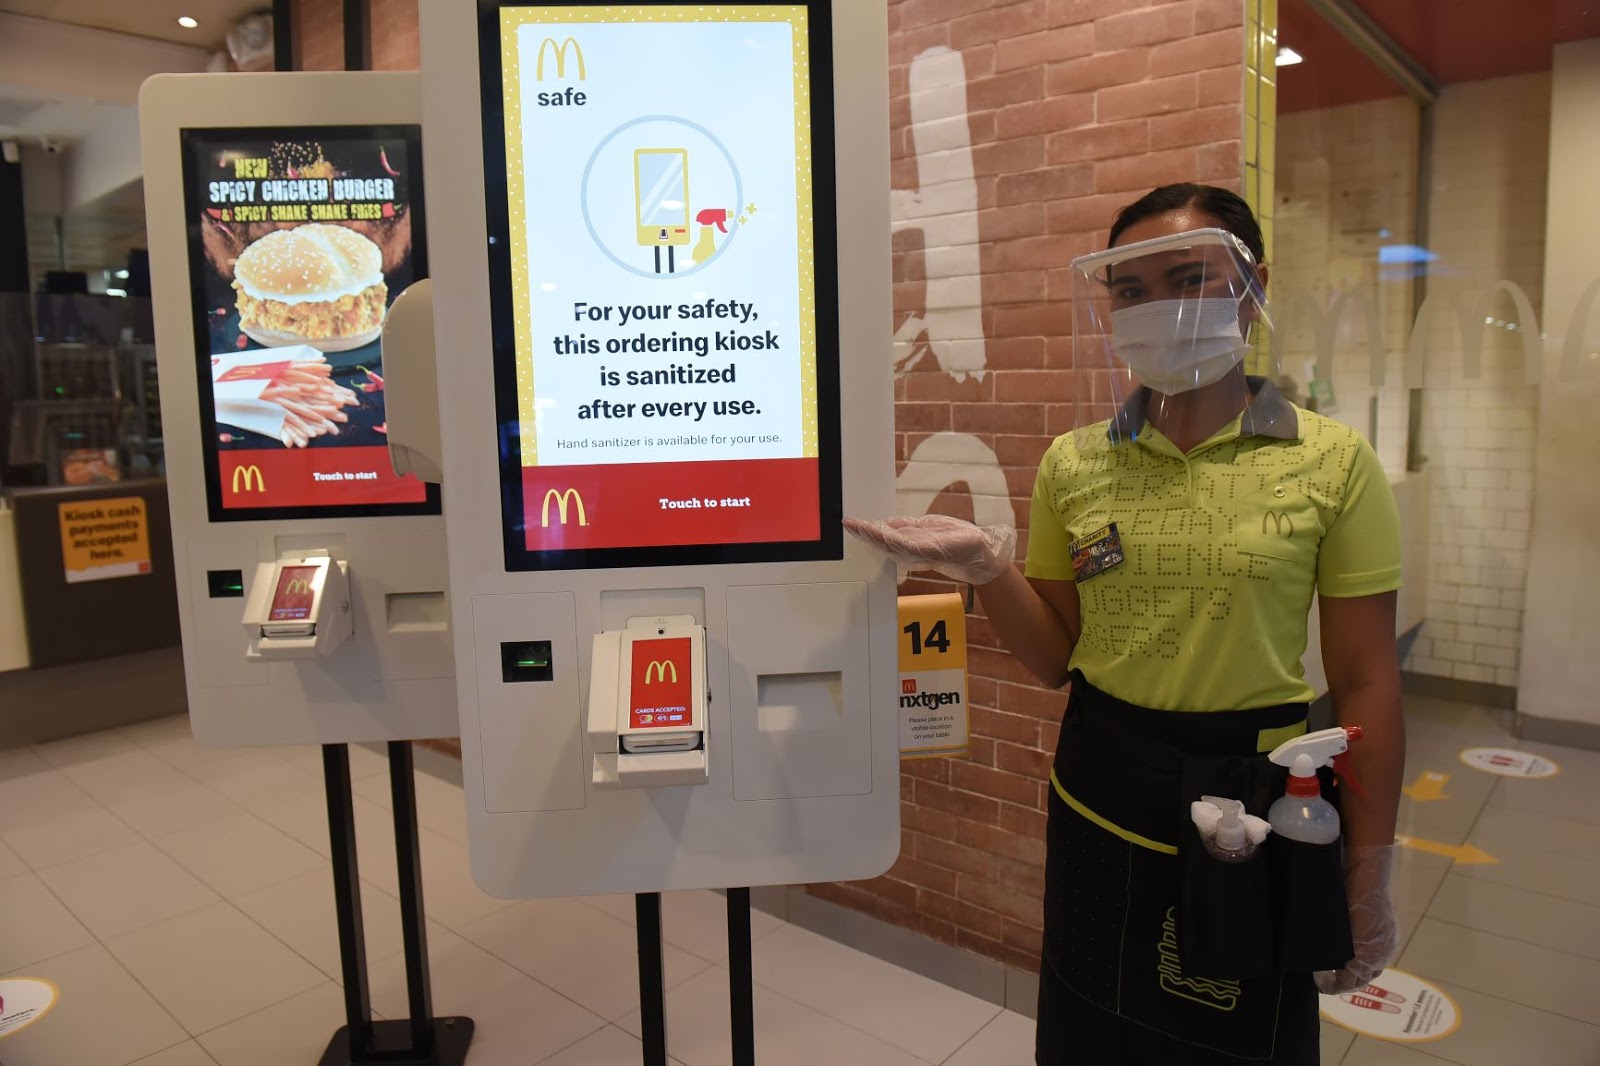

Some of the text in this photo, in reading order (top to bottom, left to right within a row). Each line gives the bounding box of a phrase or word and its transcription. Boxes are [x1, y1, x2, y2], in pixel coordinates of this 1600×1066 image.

[537, 87, 587, 107] safe
[234, 157, 269, 179] NEW
[333, 177, 395, 200] BURGER
[271, 203, 308, 221] SHAKE
[311, 203, 348, 220] SHAKE
[573, 298, 759, 326] For your safety,
[553, 330, 780, 357] this ordering kiosk
[600, 363, 737, 387] is sanitized
[577, 398, 761, 422] after every use.
[557, 433, 783, 449] Hand sanitizer is available for your use.
[313, 471, 378, 481] Touch to start
[659, 496, 751, 509] Touch to start
[903, 619, 951, 655] 14
[635, 706, 655, 714] CARDS
[900, 691, 960, 711] nxtgen
